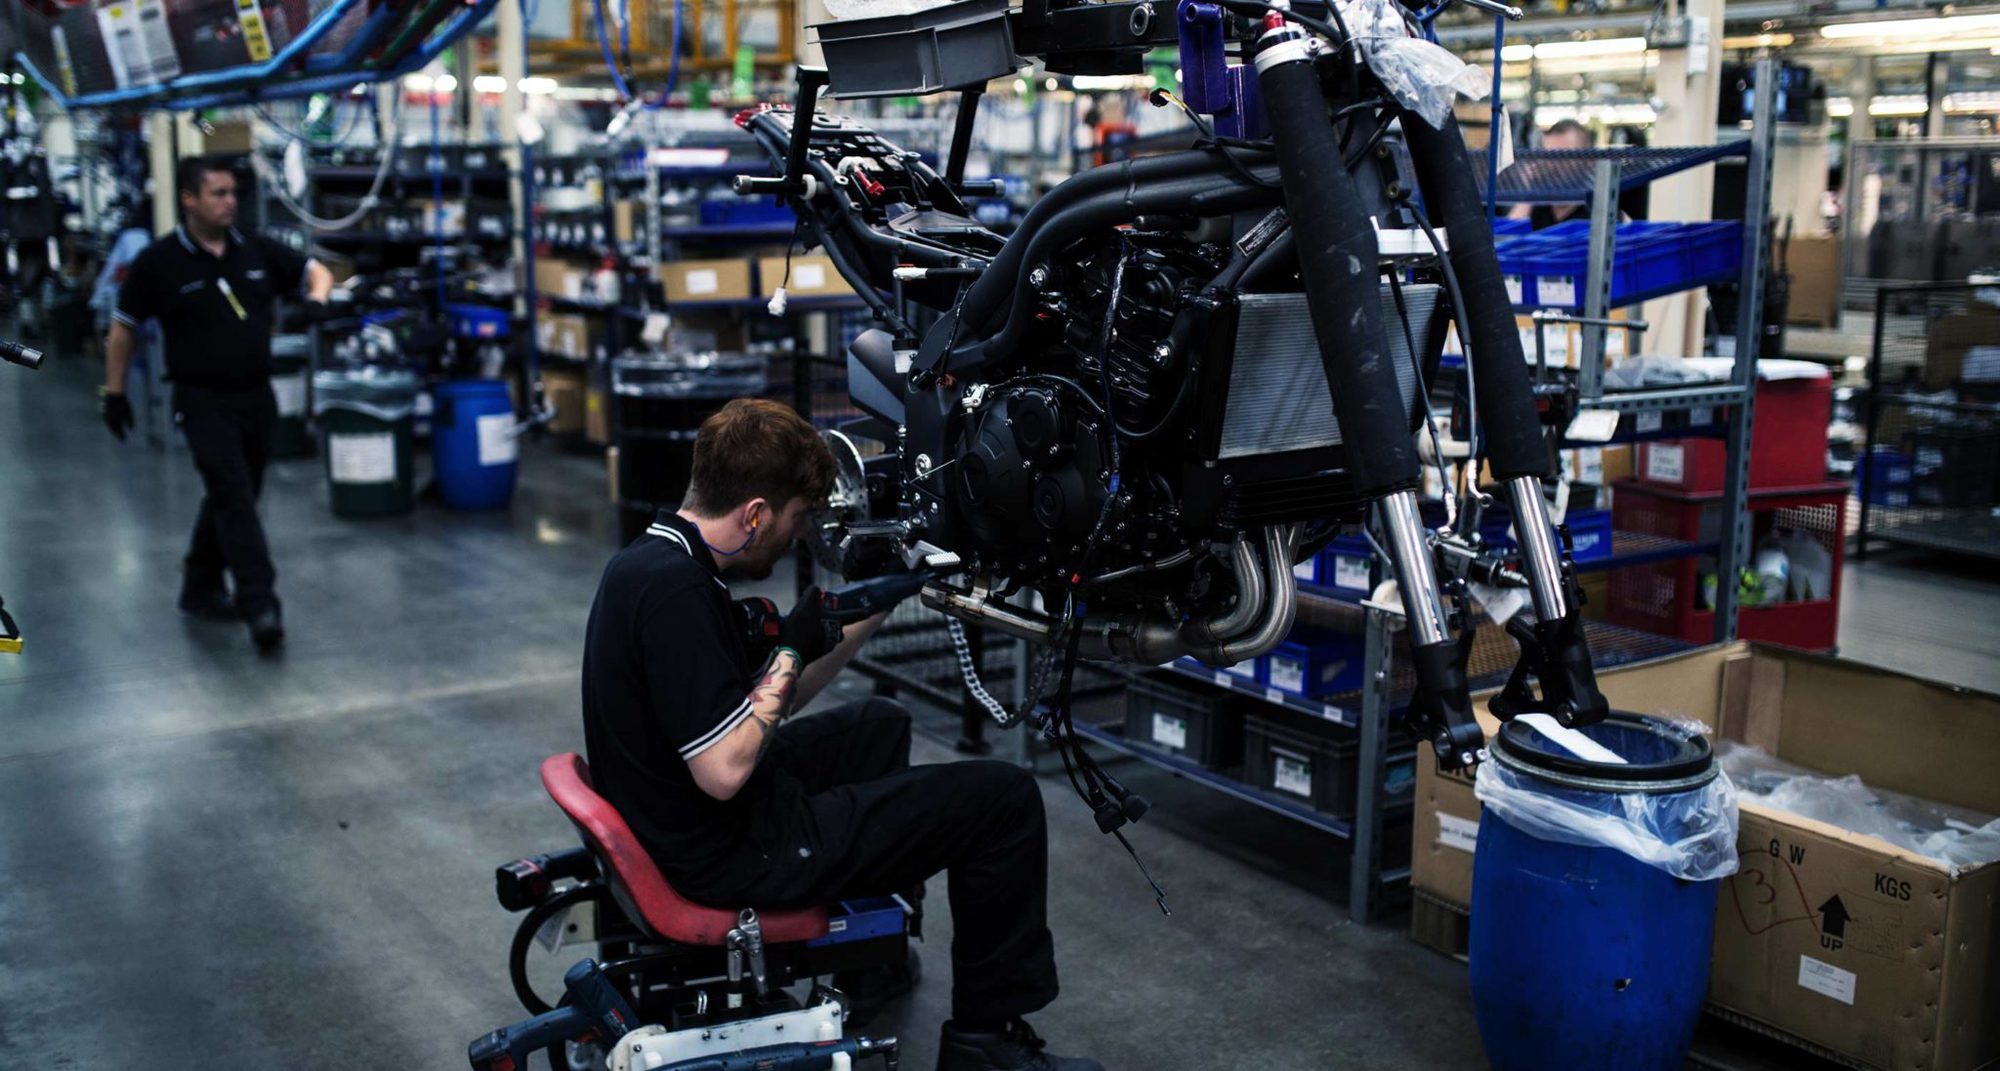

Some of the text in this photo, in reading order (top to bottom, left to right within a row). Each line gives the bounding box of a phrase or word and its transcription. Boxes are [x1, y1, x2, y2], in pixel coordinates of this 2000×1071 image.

[1744, 868, 1776, 904] 3
[1874, 872, 1912, 902] KGS
[1820, 934, 1844, 952] UP
